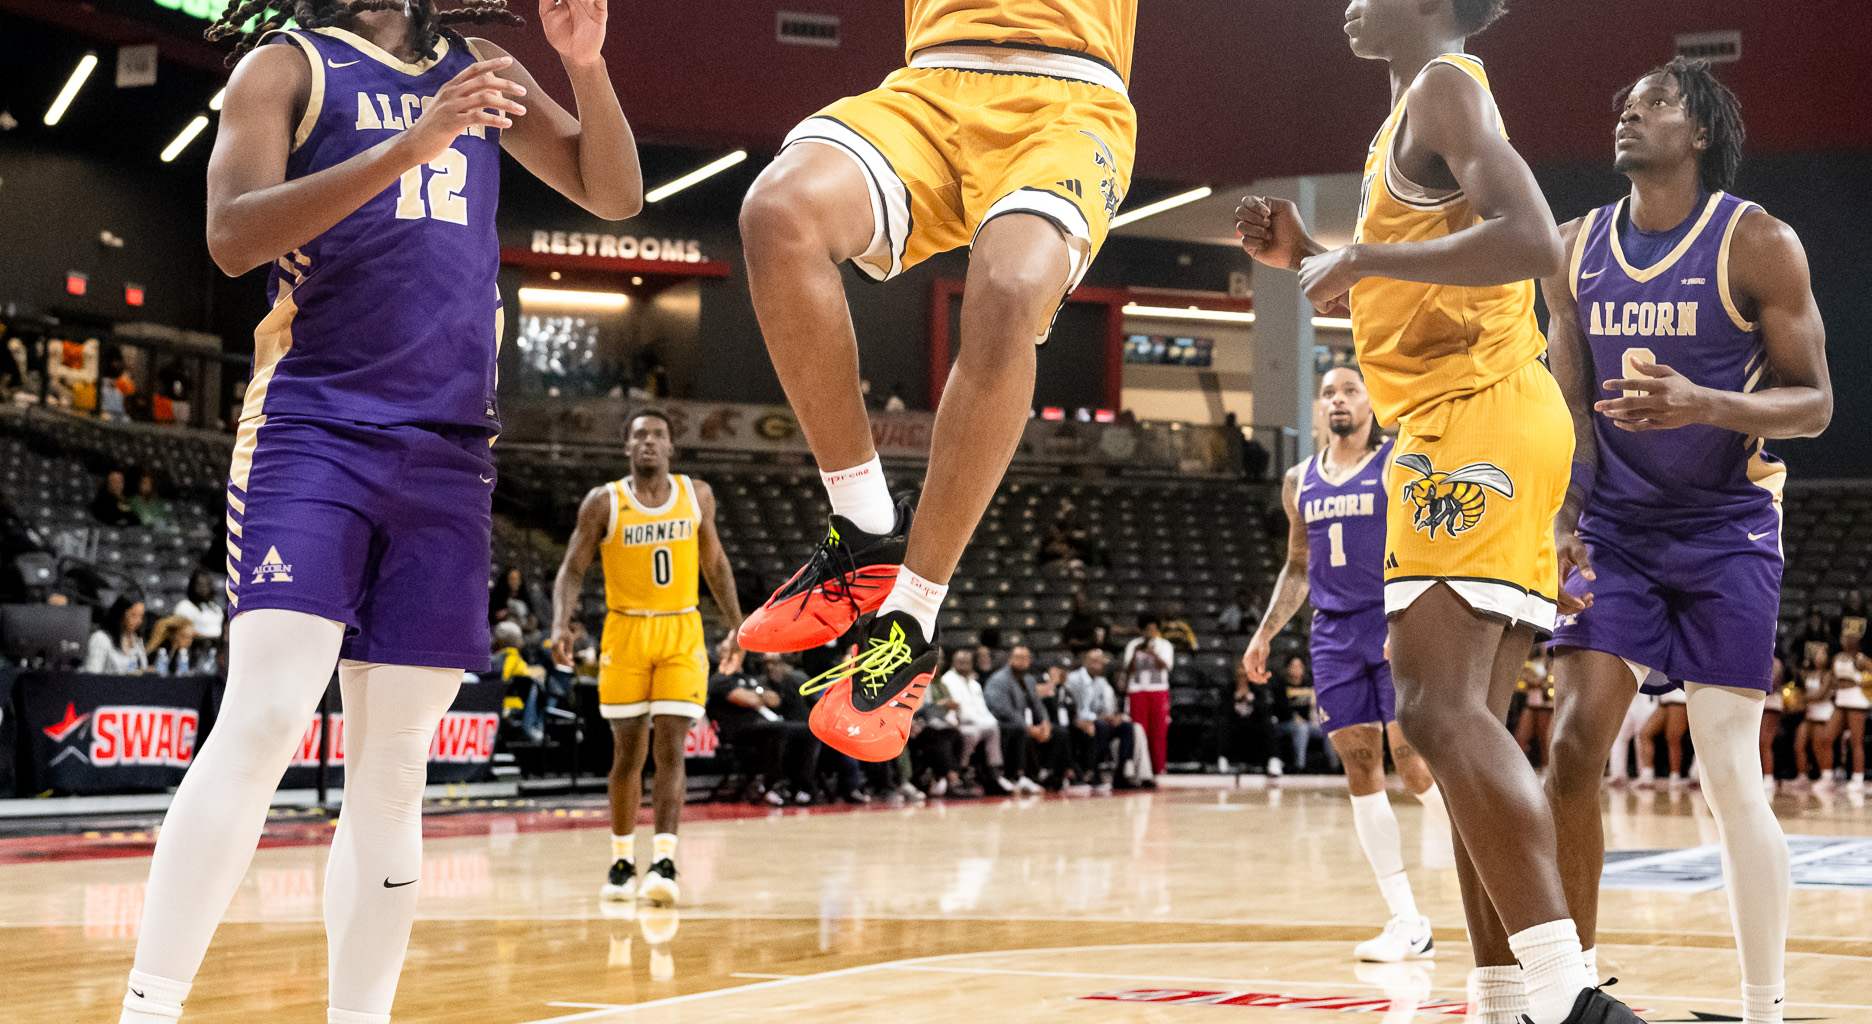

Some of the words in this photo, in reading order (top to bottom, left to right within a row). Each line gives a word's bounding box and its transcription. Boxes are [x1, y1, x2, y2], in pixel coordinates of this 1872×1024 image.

[355, 91, 486, 140] ALC
[395, 148, 468, 226] 12
[531, 230, 701, 263] RESTROOMS
[1590, 301, 1698, 336] ALCORN
[1304, 492, 1375, 524] ALCORN
[651, 546, 673, 588] 0
[1328, 522, 1347, 567] 1
[90, 706, 199, 767] SWAC
[427, 712, 499, 762] WAC
